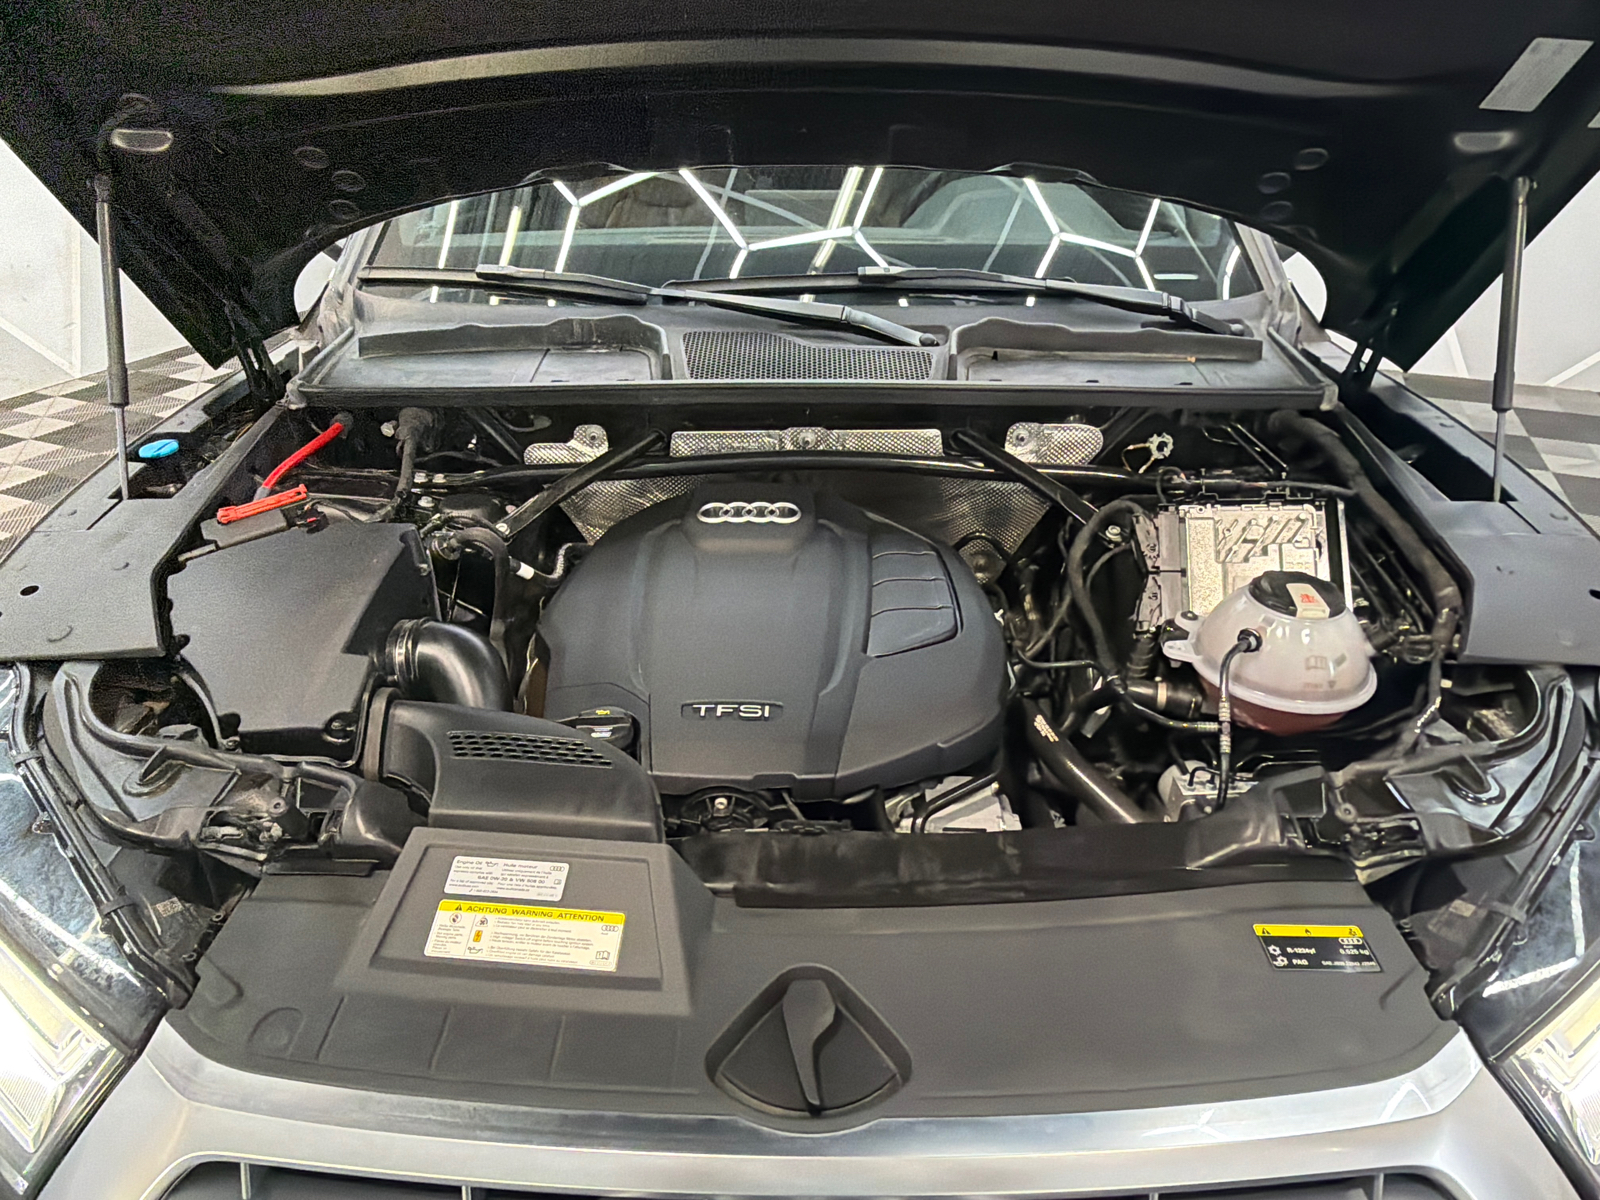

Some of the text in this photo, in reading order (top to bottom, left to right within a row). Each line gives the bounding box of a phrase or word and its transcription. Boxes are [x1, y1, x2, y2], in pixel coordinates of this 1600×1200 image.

[692, 704, 770, 718] TFSI
[466, 905, 508, 914] ACHTUNG
[511, 908, 553, 918] WARNING
[556, 912, 604, 922] ATTENTION
